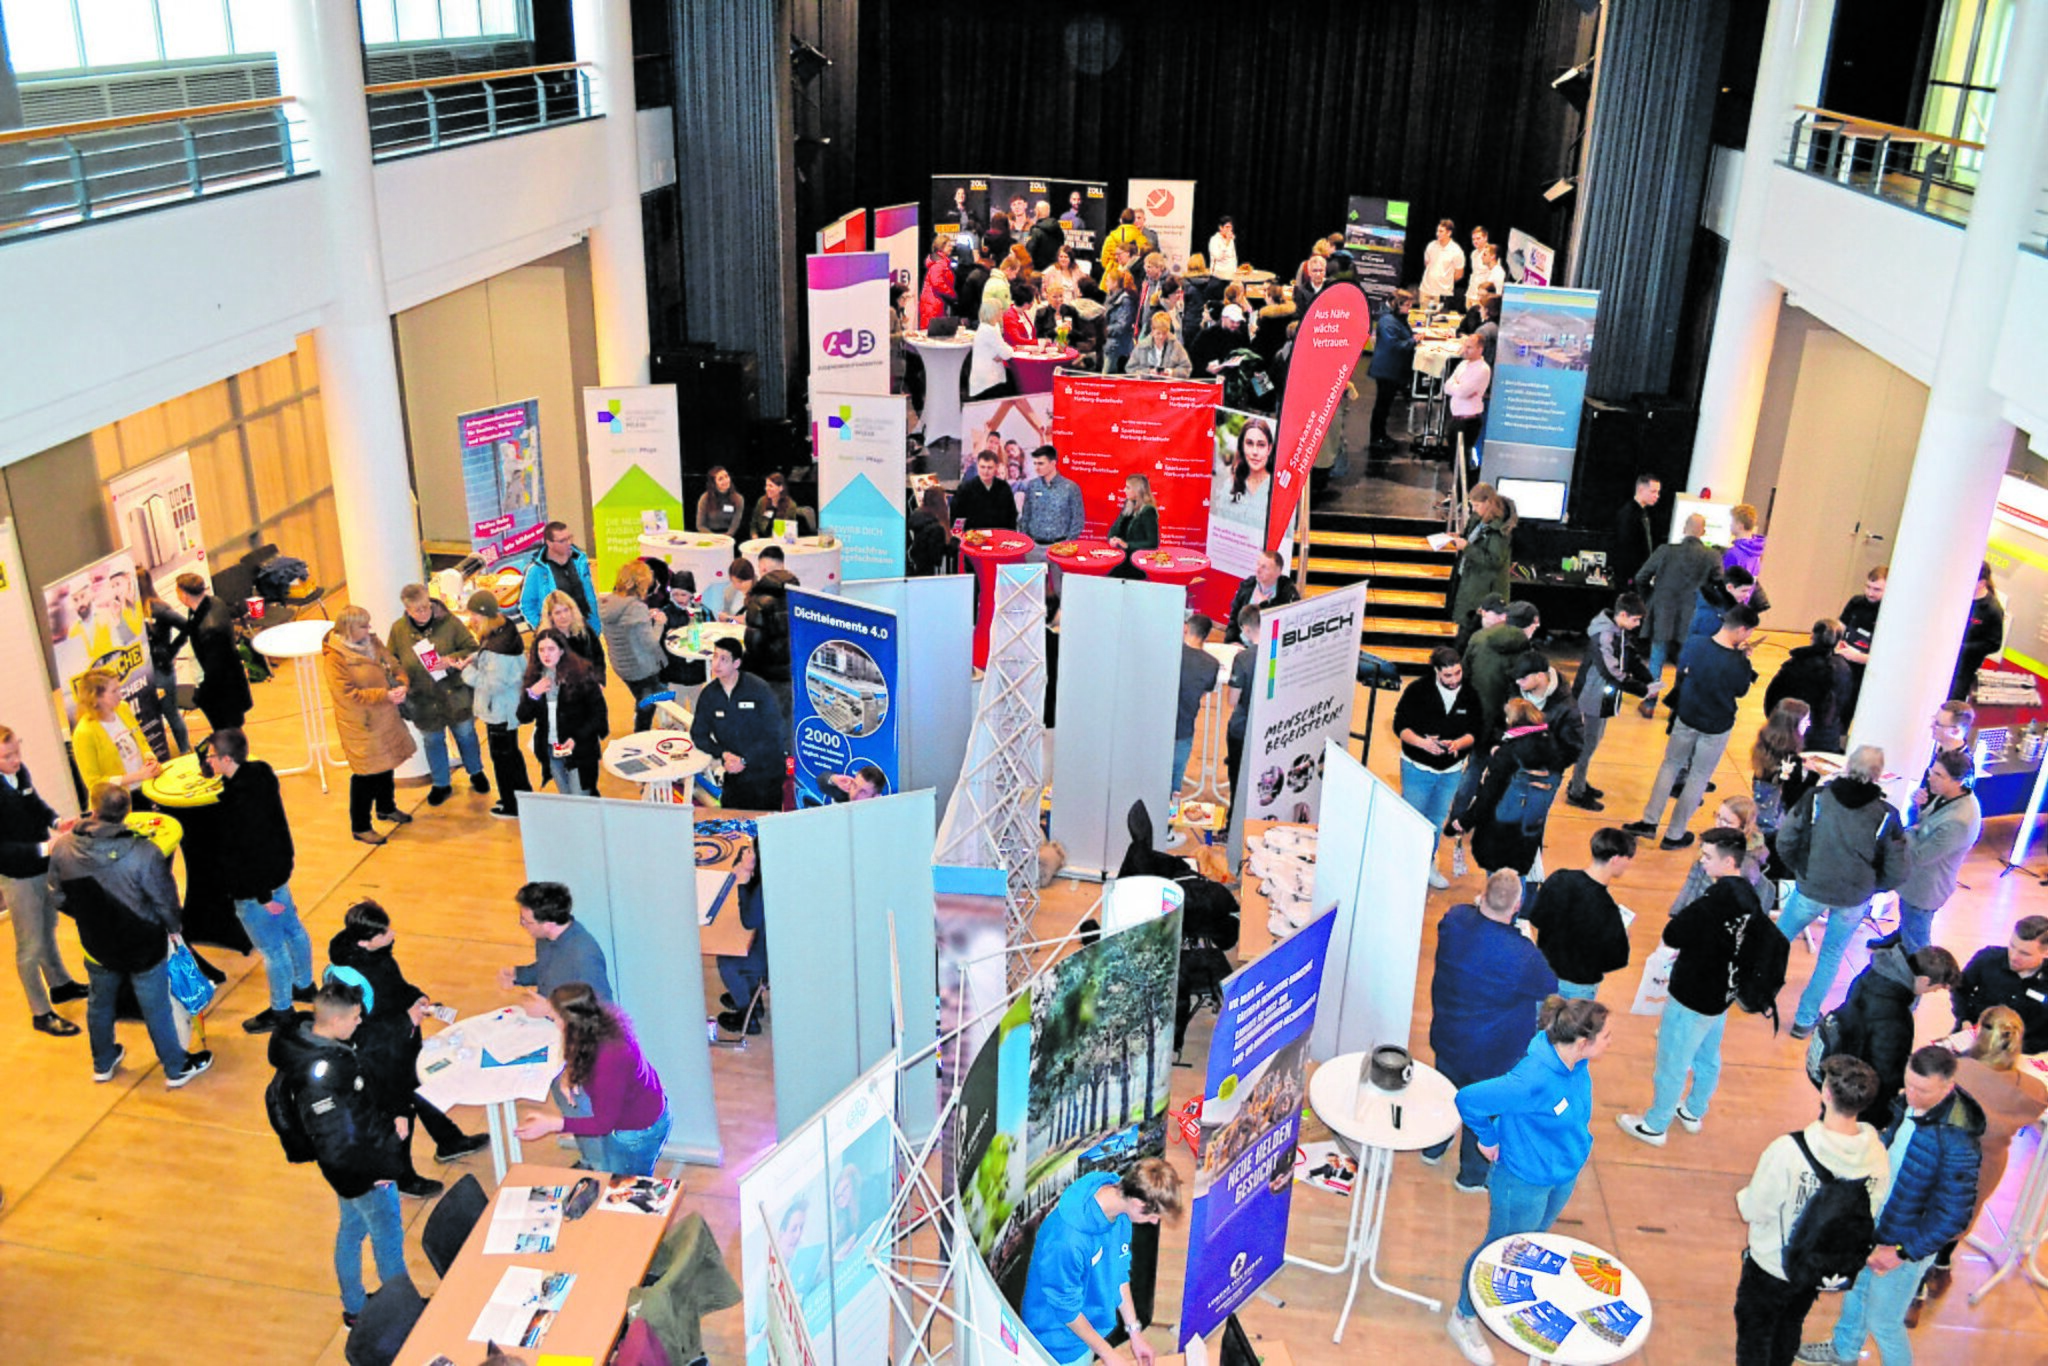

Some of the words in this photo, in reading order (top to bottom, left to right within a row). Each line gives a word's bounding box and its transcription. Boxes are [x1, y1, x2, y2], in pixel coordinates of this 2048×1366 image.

[1313, 323, 1339, 333] wächst
[1314, 309, 1329, 320] Aus
[1330, 309, 1350, 320] Nähe
[1313, 338, 1350, 348] Vertrauen.
[1298, 363, 1348, 474] Harburg-Buxtehude
[1289, 410, 1317, 468] Sparkasse
[794, 606, 868, 634] Dichtelemente
[870, 625, 888, 640] 4.0
[1282, 612, 1354, 648] BUSCH
[804, 727, 840, 748] 2000
[1264, 696, 1335, 740] MENSCHEN
[1265, 704, 1344, 756] BEGEISTERN!
[1227, 1152, 1253, 1192] NEUE
[1255, 1120, 1293, 1165] HELDEN
[1234, 1151, 1280, 1204] GESUCHT
